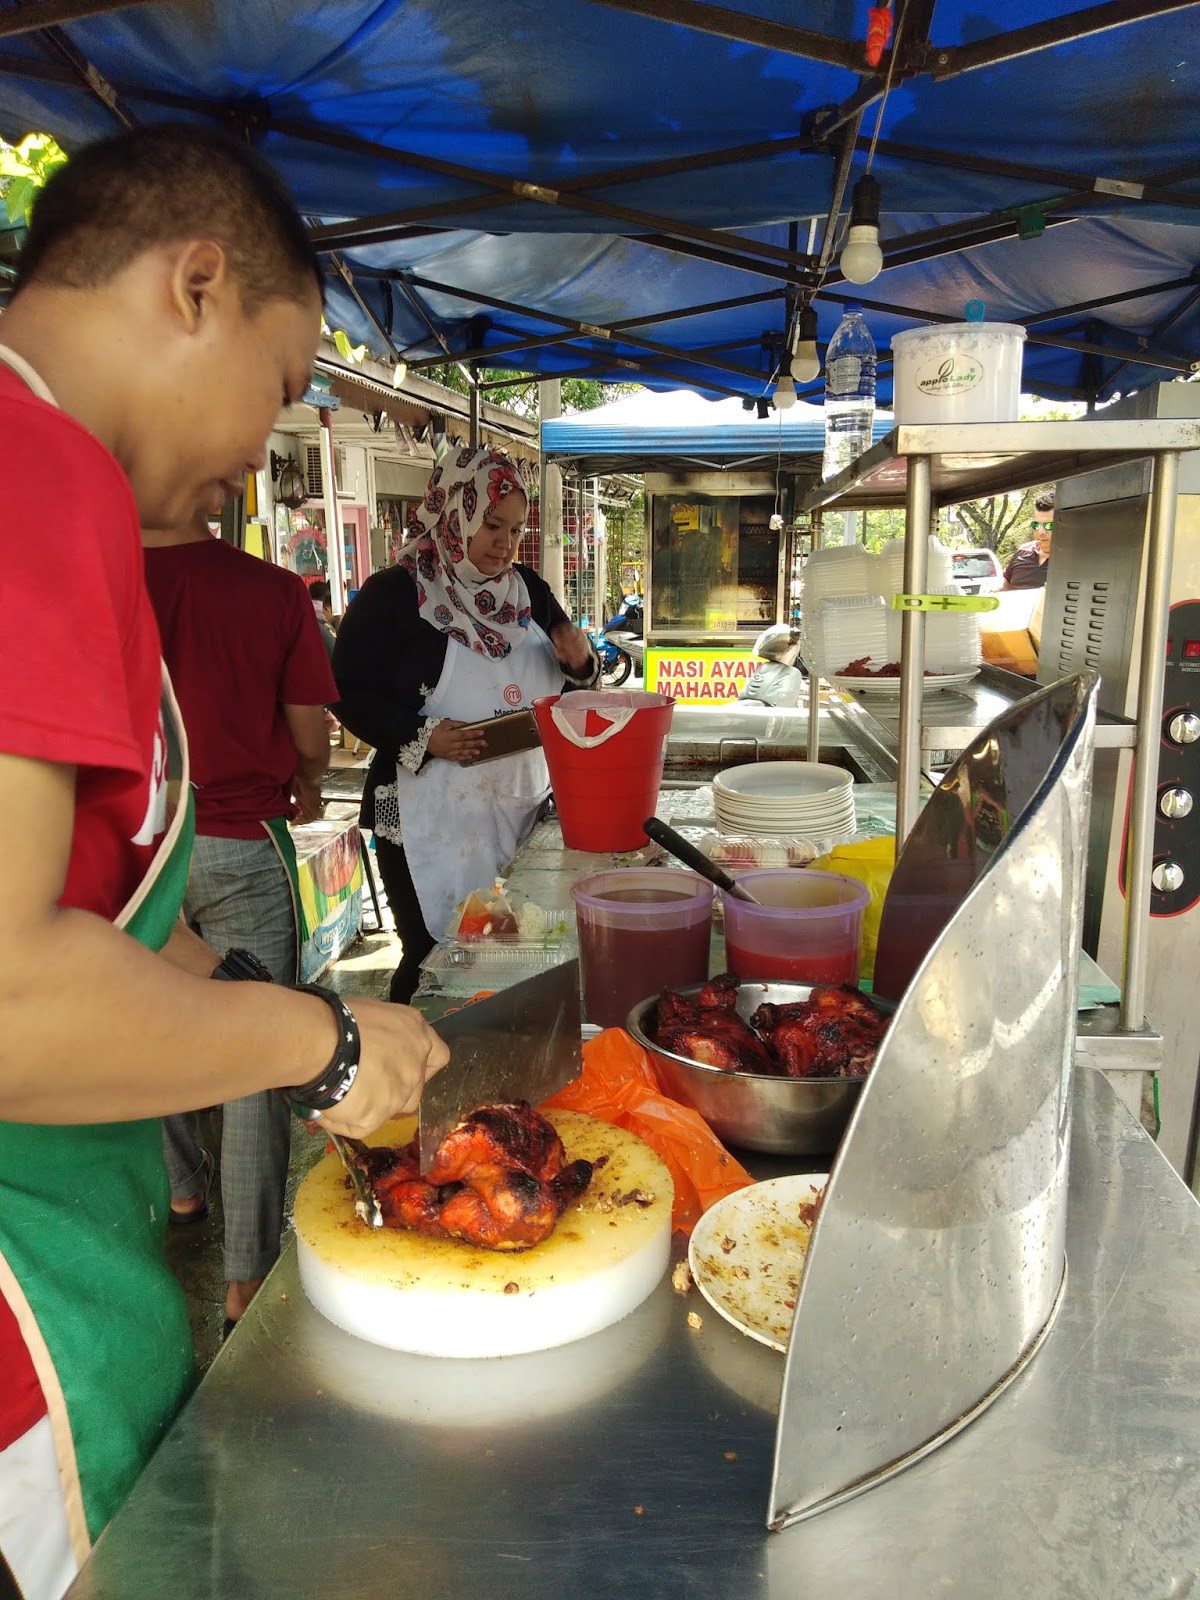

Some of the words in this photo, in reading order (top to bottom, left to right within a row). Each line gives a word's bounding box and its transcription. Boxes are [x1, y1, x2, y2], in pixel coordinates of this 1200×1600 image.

[659, 661, 703, 677] NASI
[710, 661, 763, 678] AYAM
[657, 681, 739, 698] MAHARA
[330, 1064, 358, 1101] FILA
